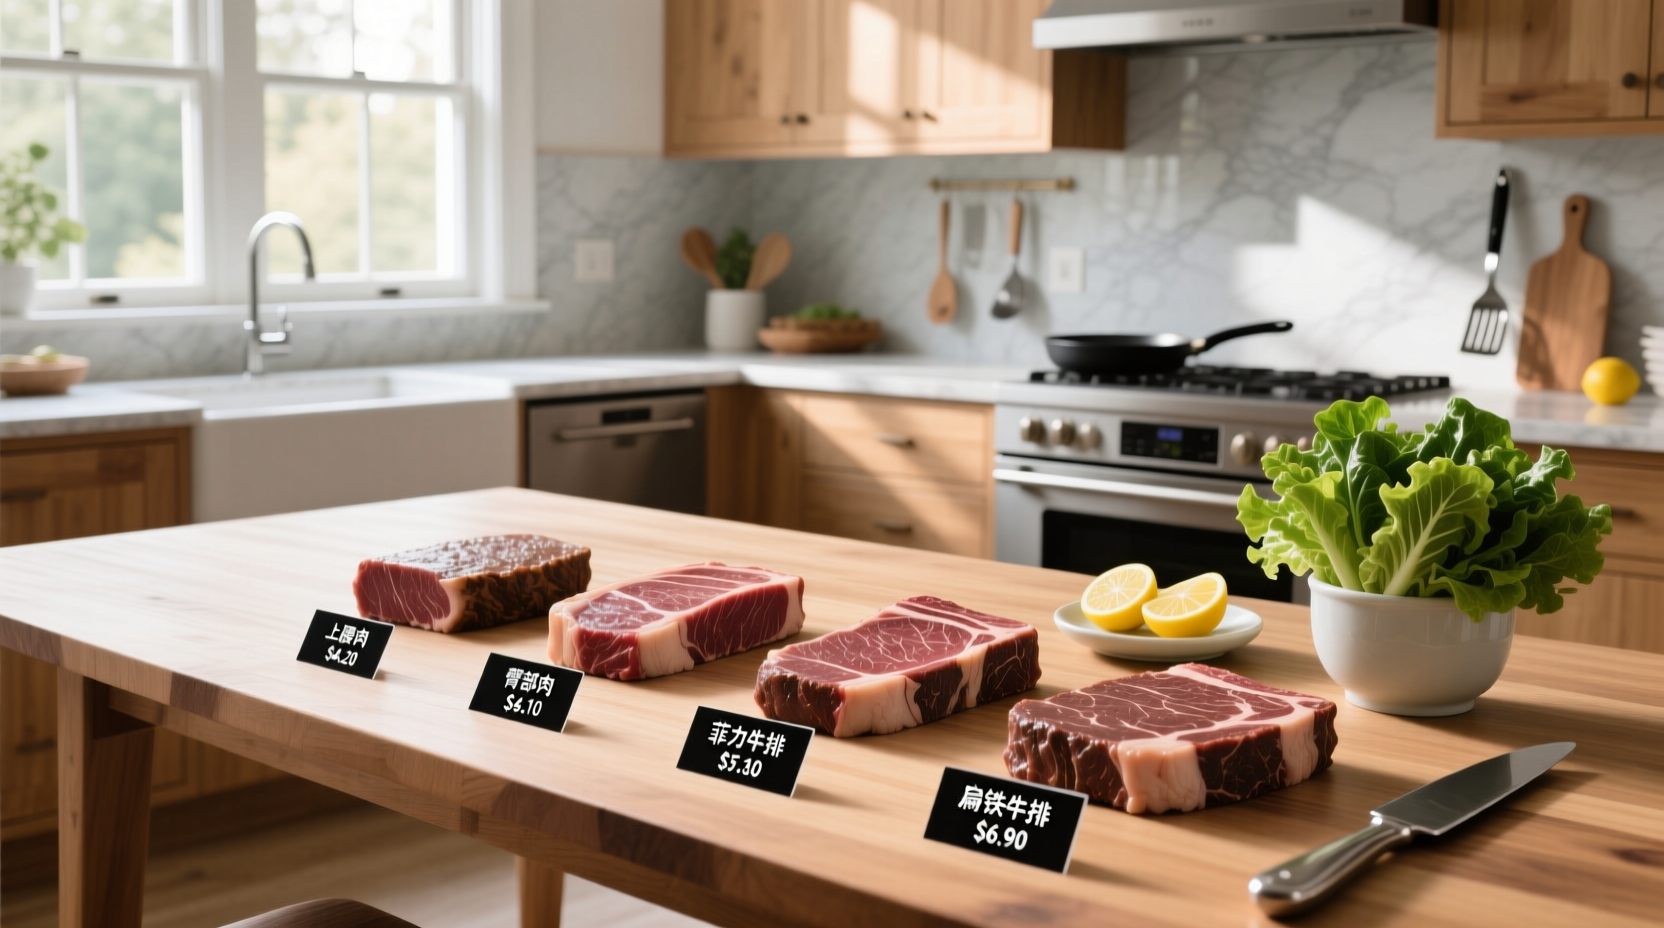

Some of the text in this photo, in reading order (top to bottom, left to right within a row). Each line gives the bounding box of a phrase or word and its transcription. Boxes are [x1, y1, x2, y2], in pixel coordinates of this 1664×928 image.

[708, 721, 786, 757] 菲力牛排
[958, 784, 1052, 827] 扁铁牛排
[974, 819, 1028, 850] $6.90
